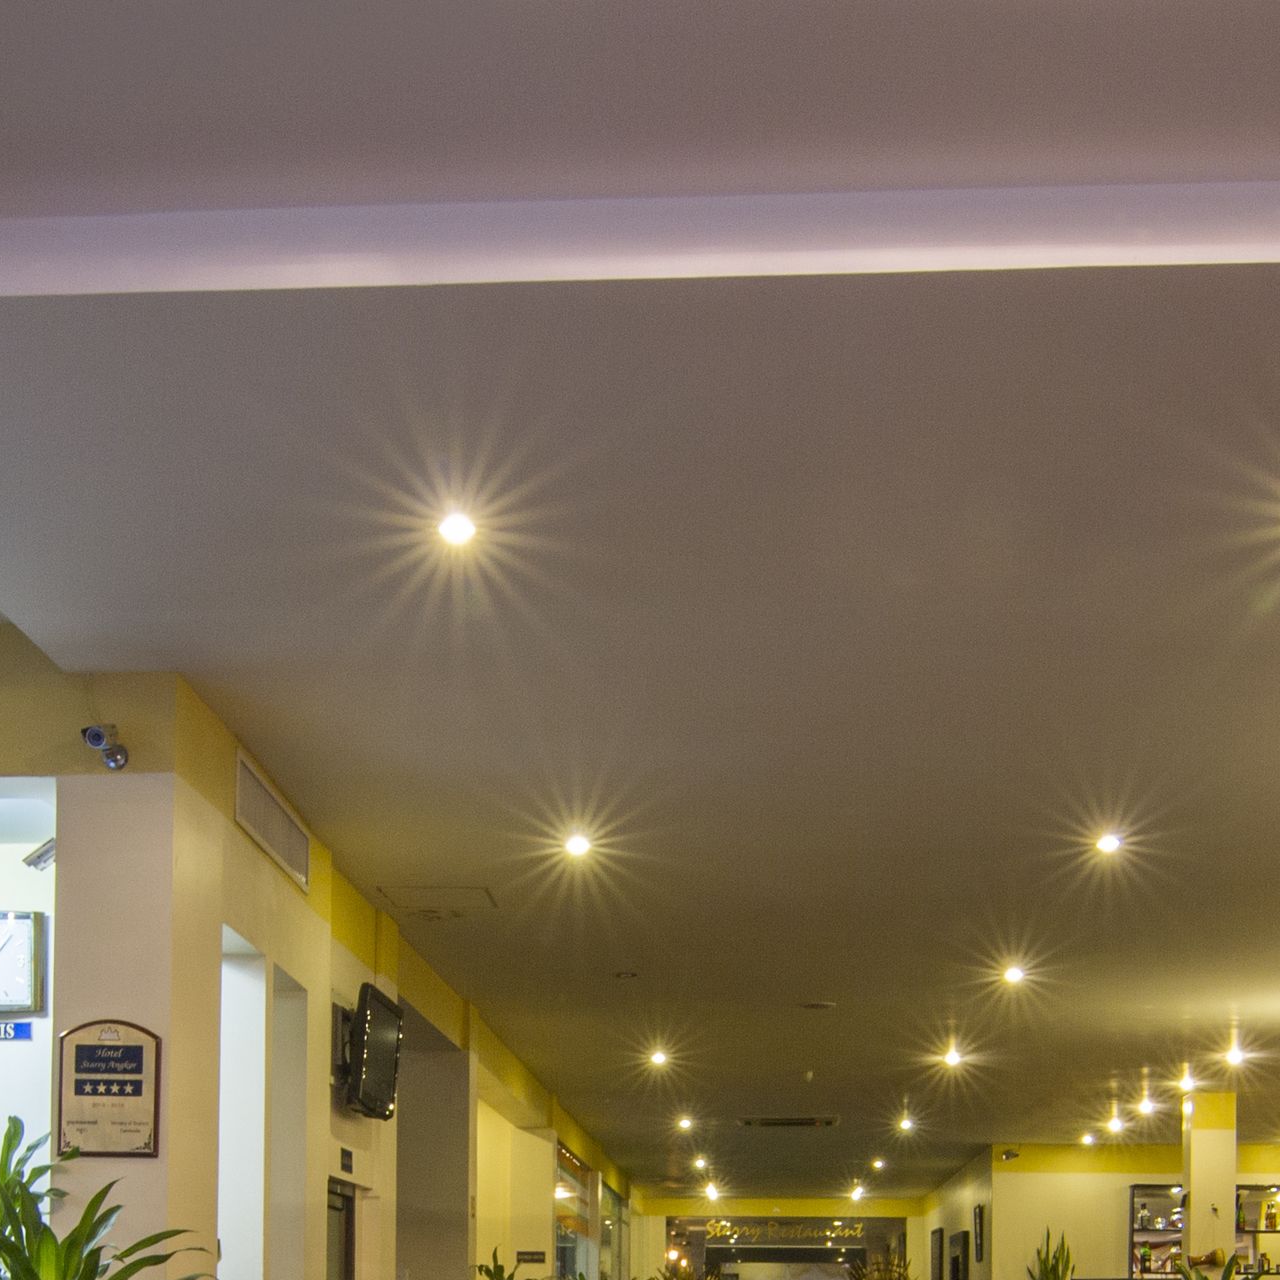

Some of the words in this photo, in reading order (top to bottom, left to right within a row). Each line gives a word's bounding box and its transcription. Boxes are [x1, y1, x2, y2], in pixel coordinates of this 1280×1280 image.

[95, 1047, 124, 1058] Hotel
[80, 1061, 107, 1071] Starry
[107, 1060, 137, 1072] Angkor
[705, 1219, 760, 1241] Starry
[768, 1220, 864, 1238] Restaurant
